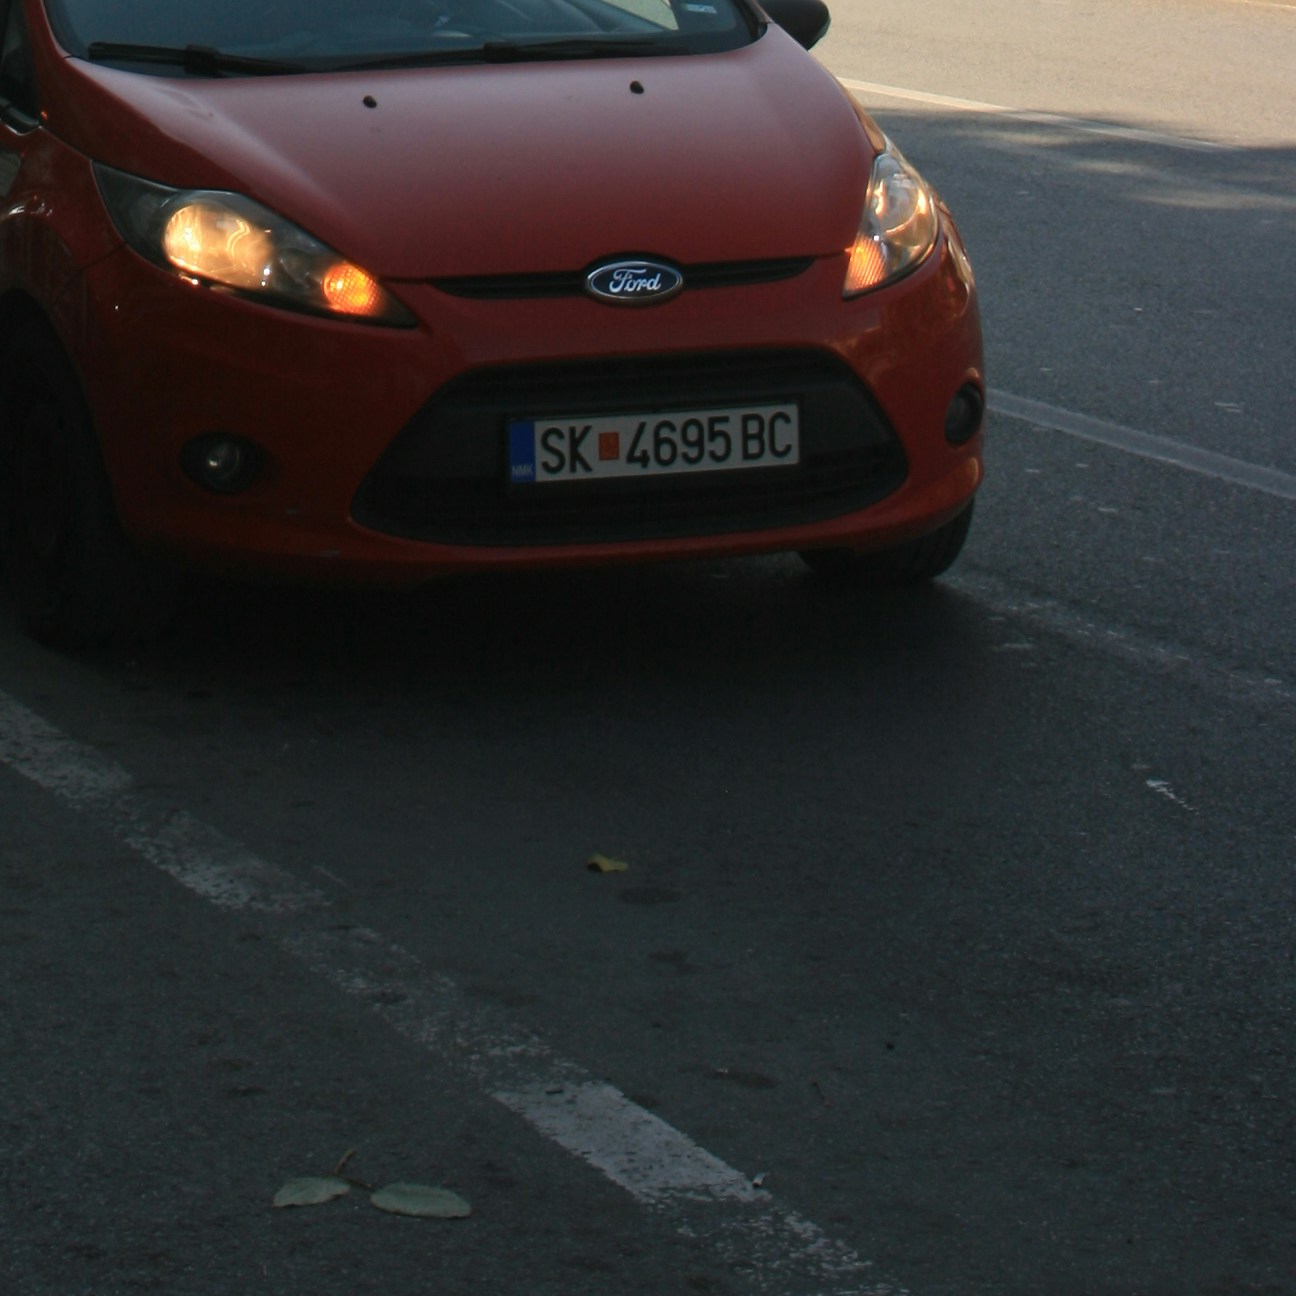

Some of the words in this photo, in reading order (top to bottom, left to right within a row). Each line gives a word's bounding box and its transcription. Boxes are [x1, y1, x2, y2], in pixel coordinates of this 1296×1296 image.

[609, 268, 661, 293] Ford
[540, 425, 594, 474] SK
[626, 415, 732, 469] 4695
[741, 411, 793, 461] BC
[511, 463, 534, 478] NMK
